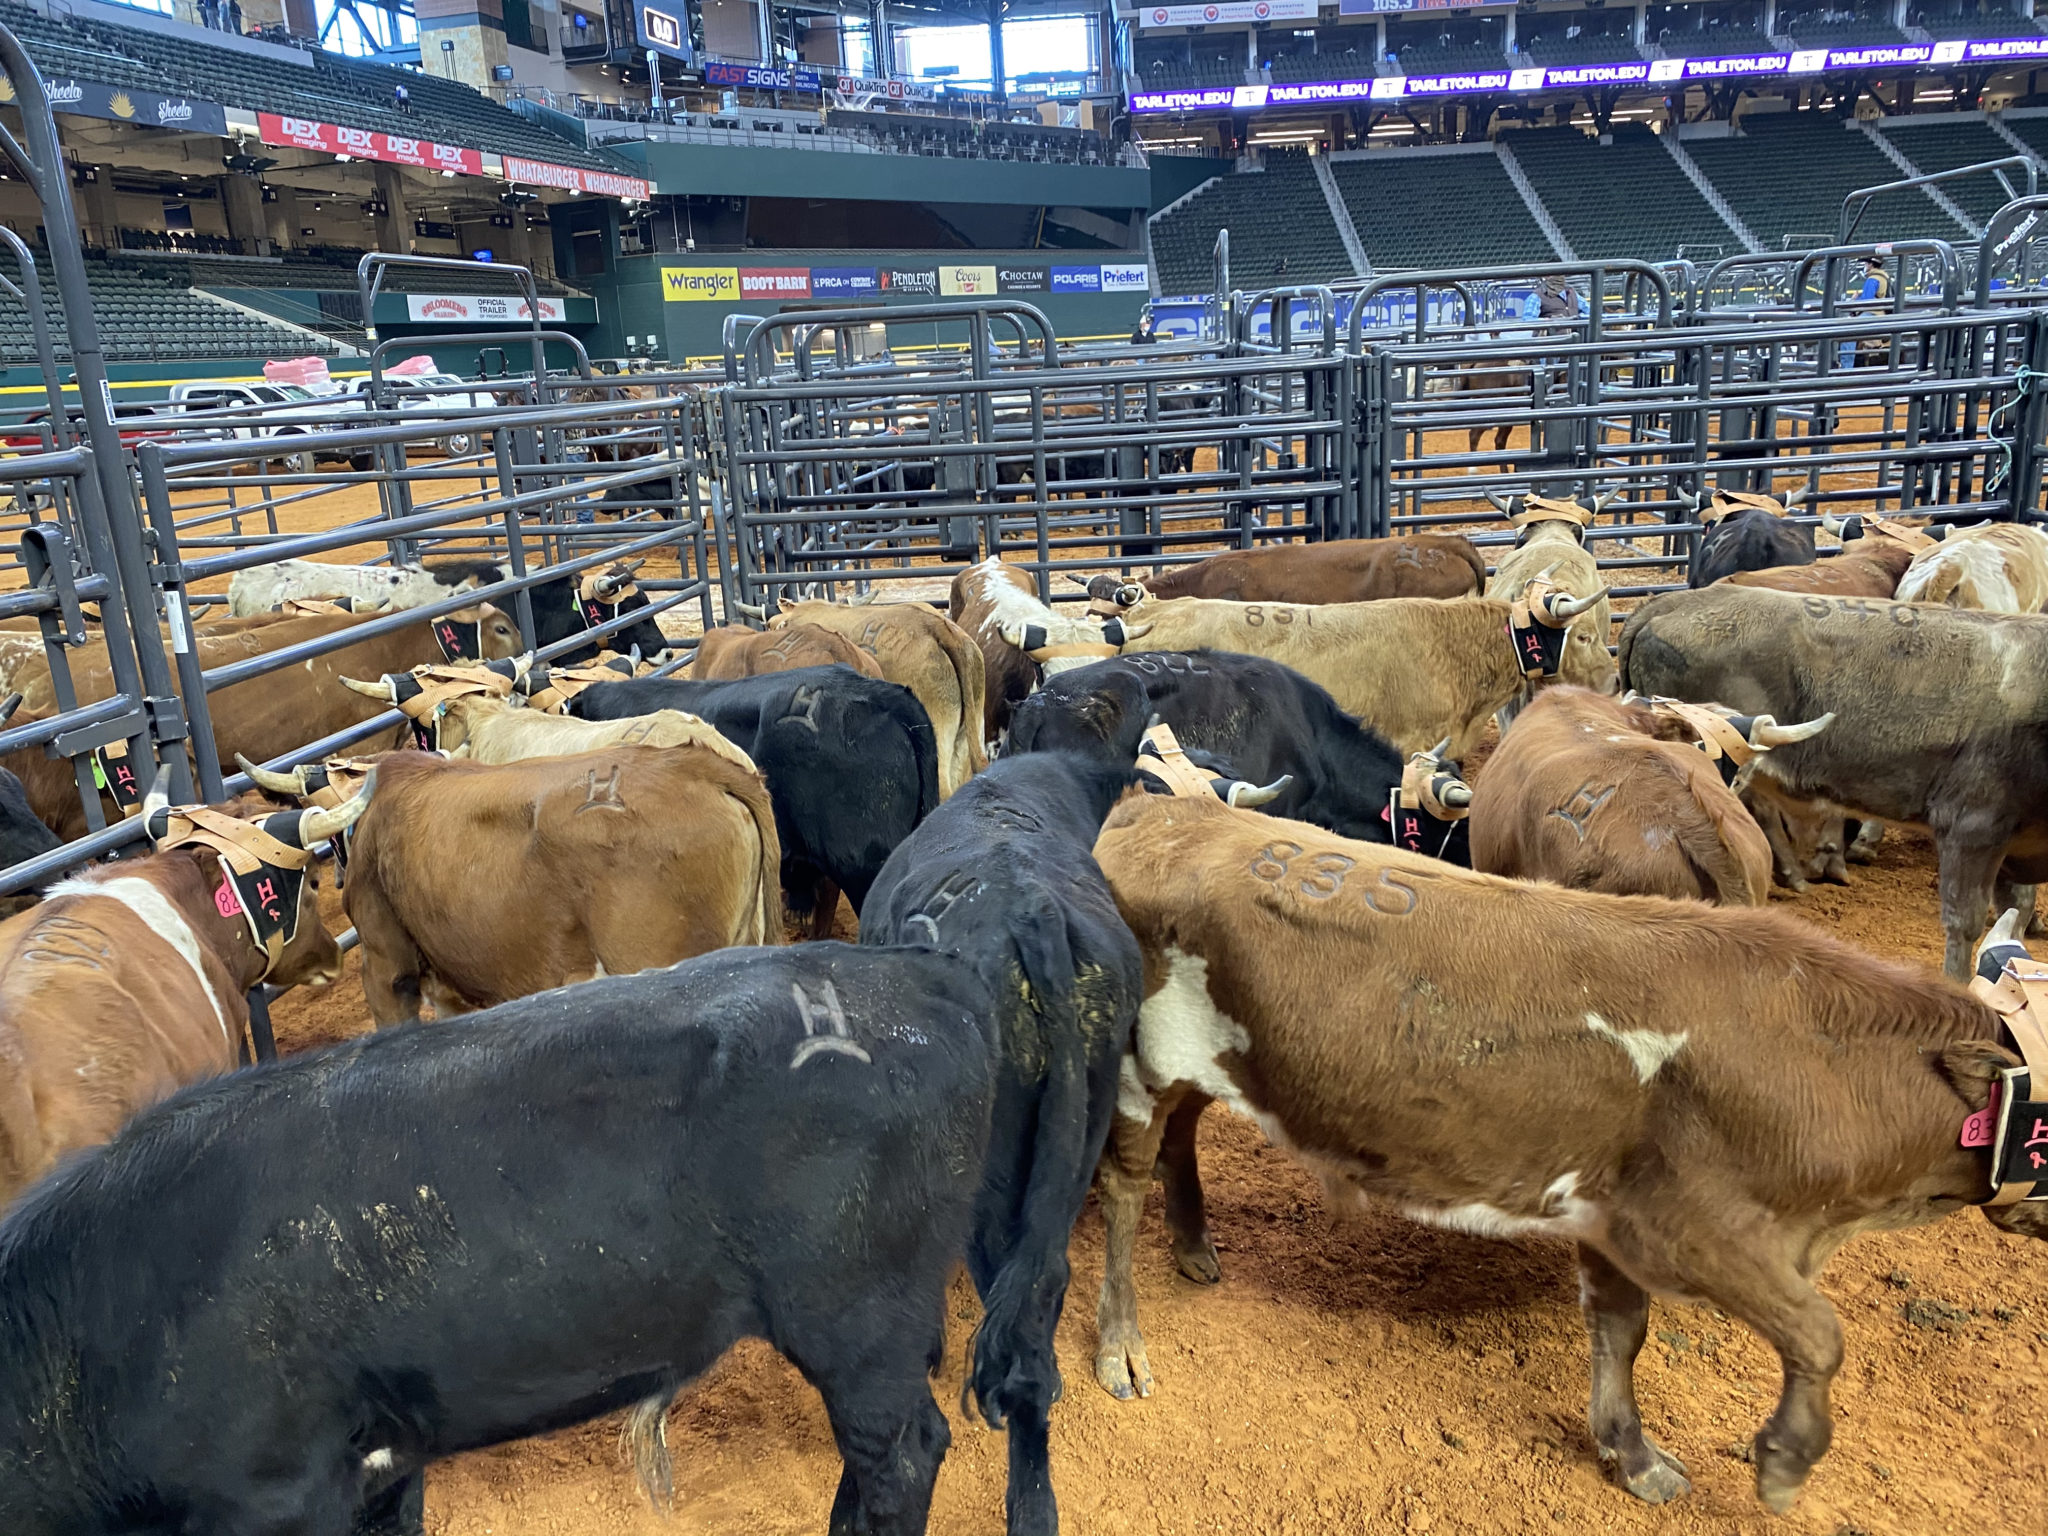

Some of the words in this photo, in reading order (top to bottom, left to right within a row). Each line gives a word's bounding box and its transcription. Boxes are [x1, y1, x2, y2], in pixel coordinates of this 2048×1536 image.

[653, 16, 673, 42] 0.0
[1133, 92, 1231, 109] TARLETON.EDU
[1270, 84, 1369, 101] TARLETON.EDU
[1408, 75, 1507, 92] TARLETON.EDU
[1547, 66, 1646, 84] TARLETON.EDU
[1687, 57, 1786, 75] TARLETON.EDU
[1830, 47, 1930, 65] TARLETON.EDU
[854, 80, 887, 95] QuikTrip
[158, 99, 192, 123] Sheela
[282, 117, 321, 139] DEX
[337, 126, 373, 147] DEX
[387, 136, 419, 156] DEX
[433, 144, 463, 163] DEX
[507, 158, 580, 189] WHATABURGER
[584, 172, 646, 198] WHATABURGER
[1993, 209, 2039, 256] Priefert
[742, 276, 774, 291] BOOT
[775, 276, 807, 291] BARN
[820, 278, 843, 288] PRCA
[892, 270, 936, 287] PENDLETON
[955, 268, 981, 282] Coors
[1000, 271, 1043, 281] CHOCTAW
[1054, 273, 1098, 284] POLARIS
[1104, 269, 1144, 283] Priefert
[667, 273, 734, 297] Wrangler
